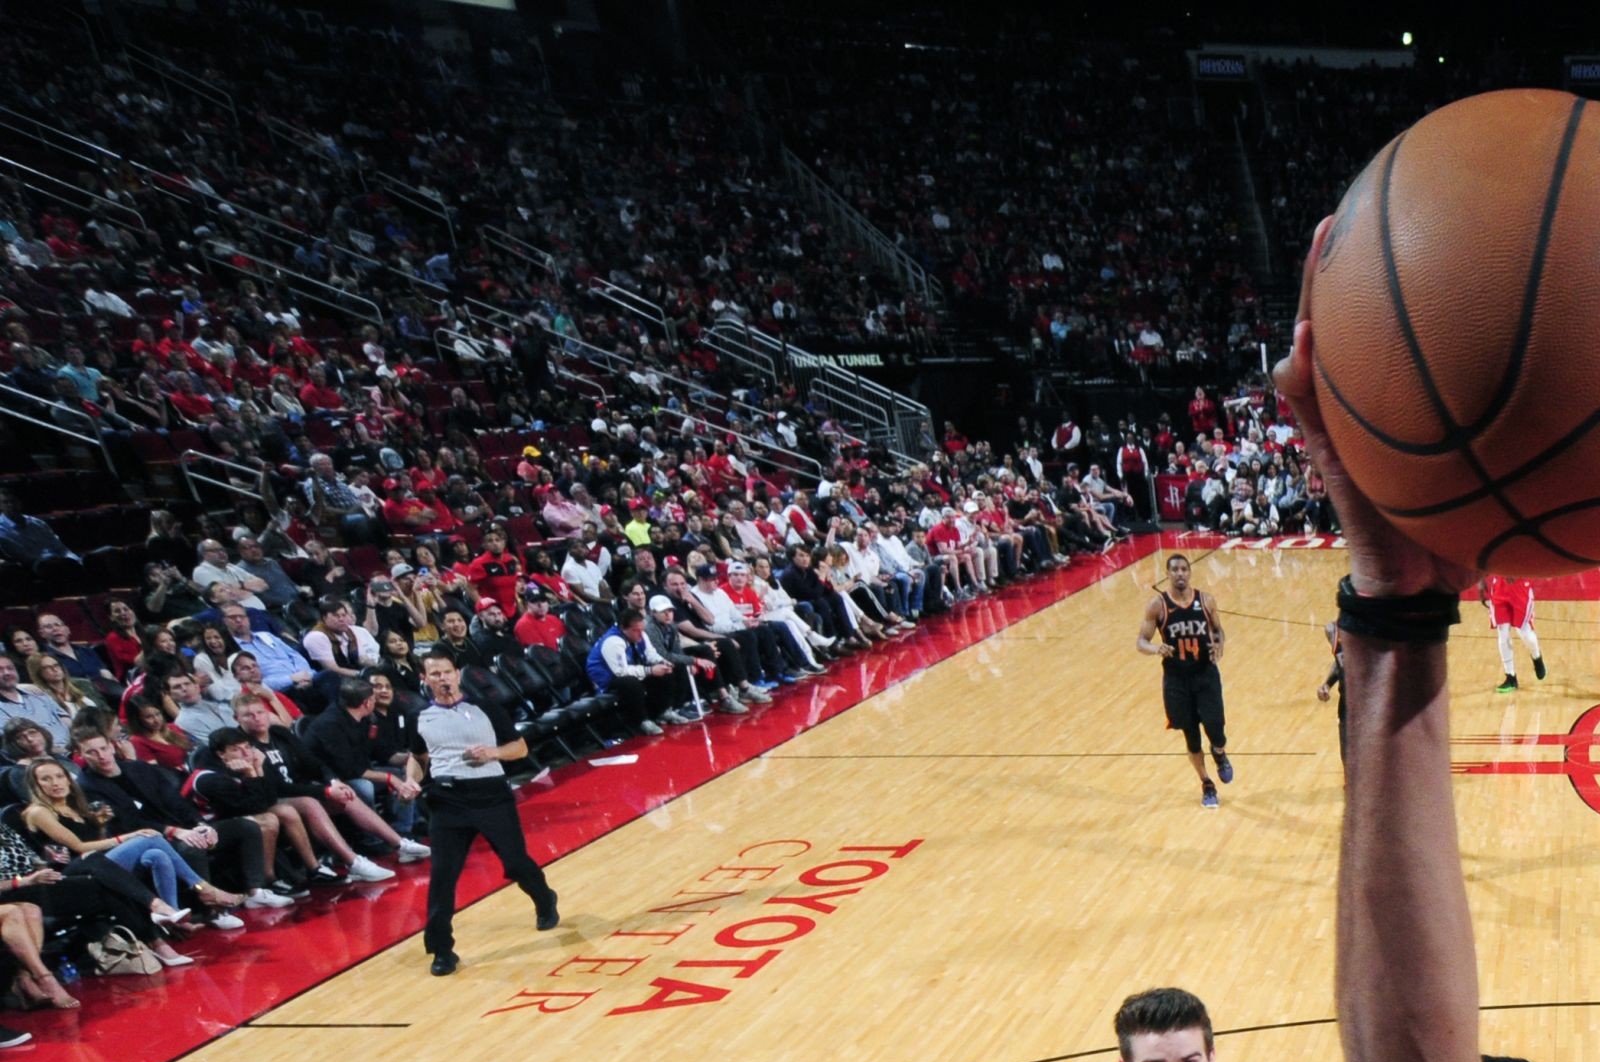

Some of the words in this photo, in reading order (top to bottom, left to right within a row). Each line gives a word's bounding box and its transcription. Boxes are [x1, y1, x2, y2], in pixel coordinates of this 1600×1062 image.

[838, 354, 884, 366] TUNNEL
[1168, 620, 1207, 638] PHX
[1178, 638, 1200, 660] 14
[482, 839, 812, 1018] CENTER
[606, 838, 924, 1017] TOYOTA
